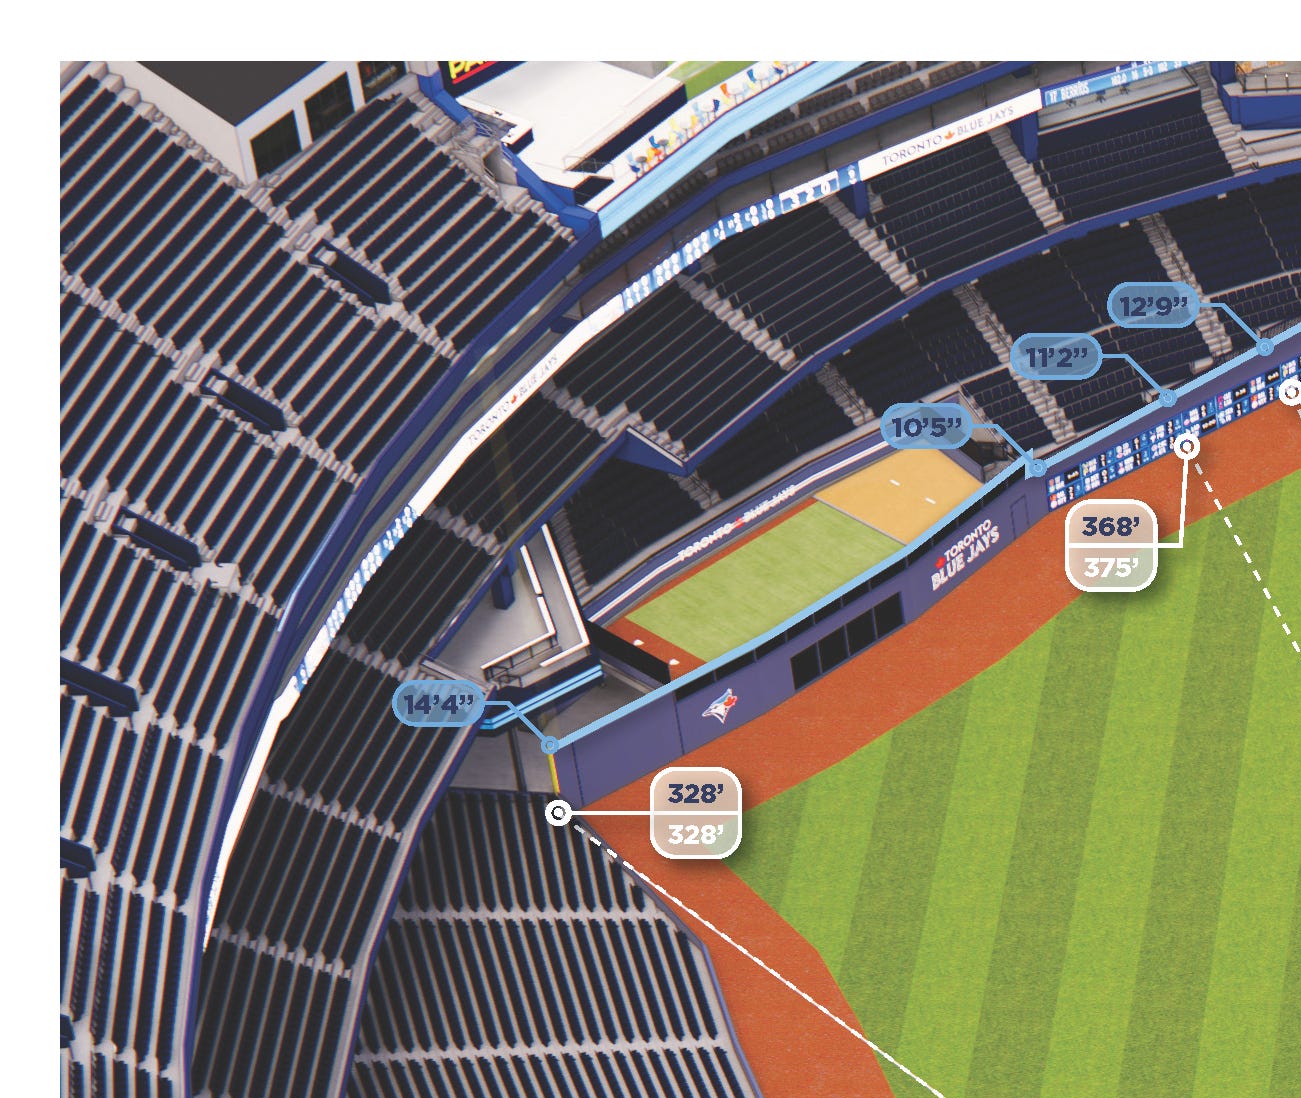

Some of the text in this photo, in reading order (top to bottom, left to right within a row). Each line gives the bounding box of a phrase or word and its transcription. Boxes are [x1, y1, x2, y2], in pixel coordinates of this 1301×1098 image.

[882, 105, 1014, 166] TORONTO BLUE JAYS
[931, 526, 1000, 591] BLUE JAYS
[944, 519, 992, 561] TORONTO
